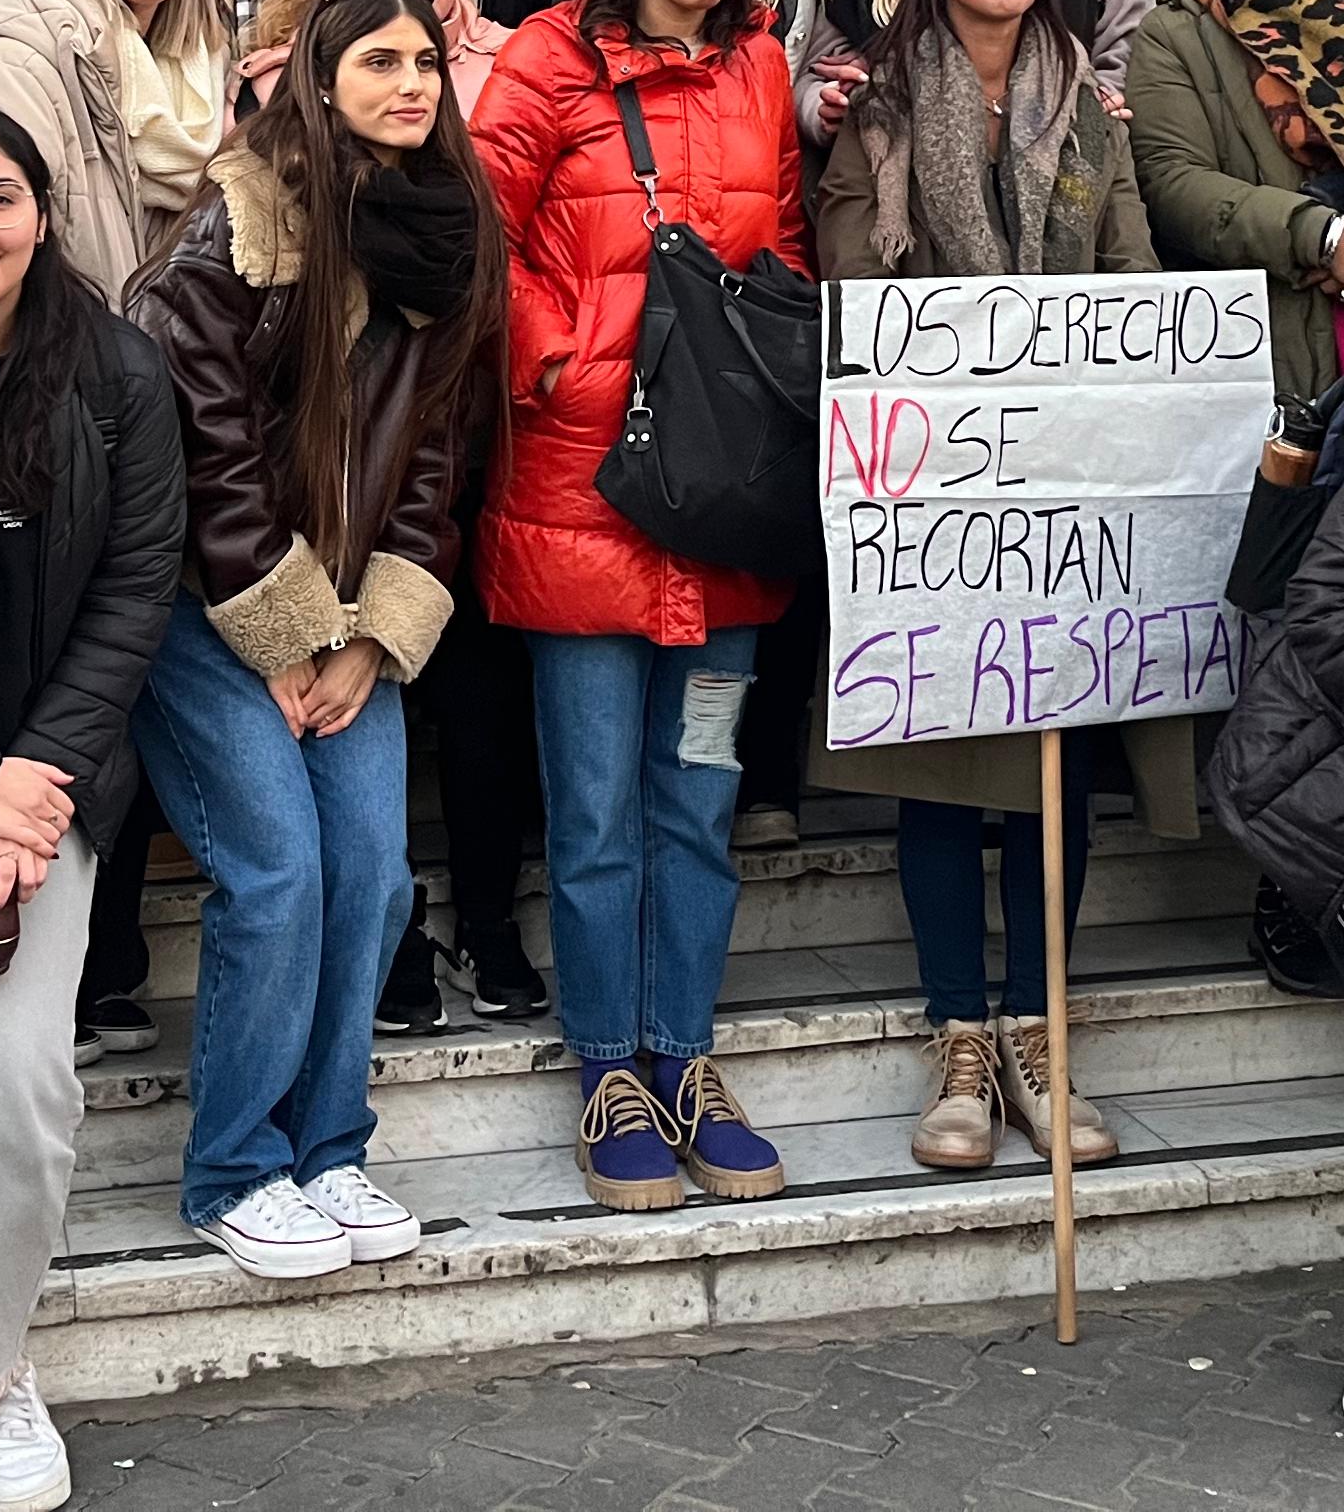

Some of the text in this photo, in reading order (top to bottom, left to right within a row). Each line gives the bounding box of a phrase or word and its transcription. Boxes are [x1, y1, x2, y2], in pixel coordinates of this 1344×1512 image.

[827, 281, 1264, 379] LOS DERECHOS
[826, 392, 1039, 498] NO SE
[829, 624, 949, 746] SE
